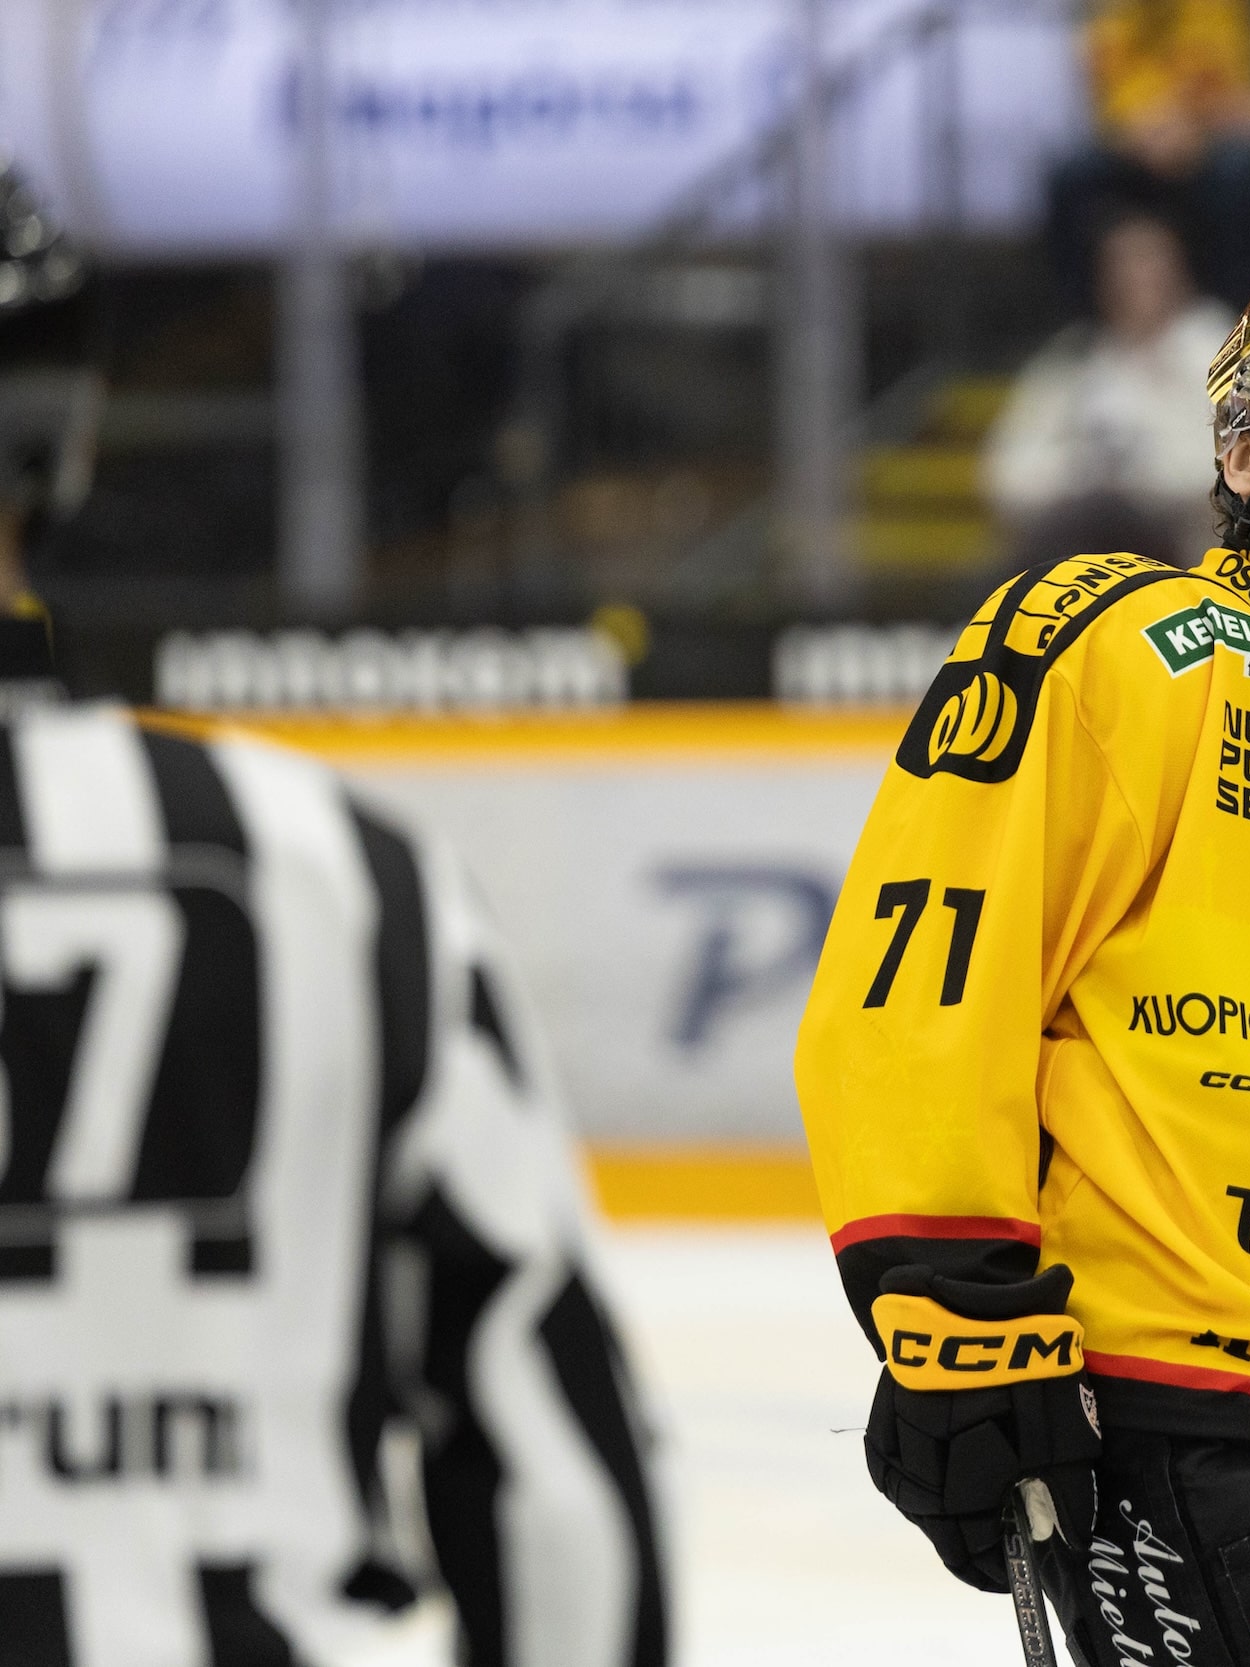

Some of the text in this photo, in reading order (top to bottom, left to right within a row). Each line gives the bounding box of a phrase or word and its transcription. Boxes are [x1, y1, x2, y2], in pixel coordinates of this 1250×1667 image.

[861, 877, 987, 1010] 71
[0, 888, 188, 1203] 7
[891, 1328, 1075, 1372] CCM
